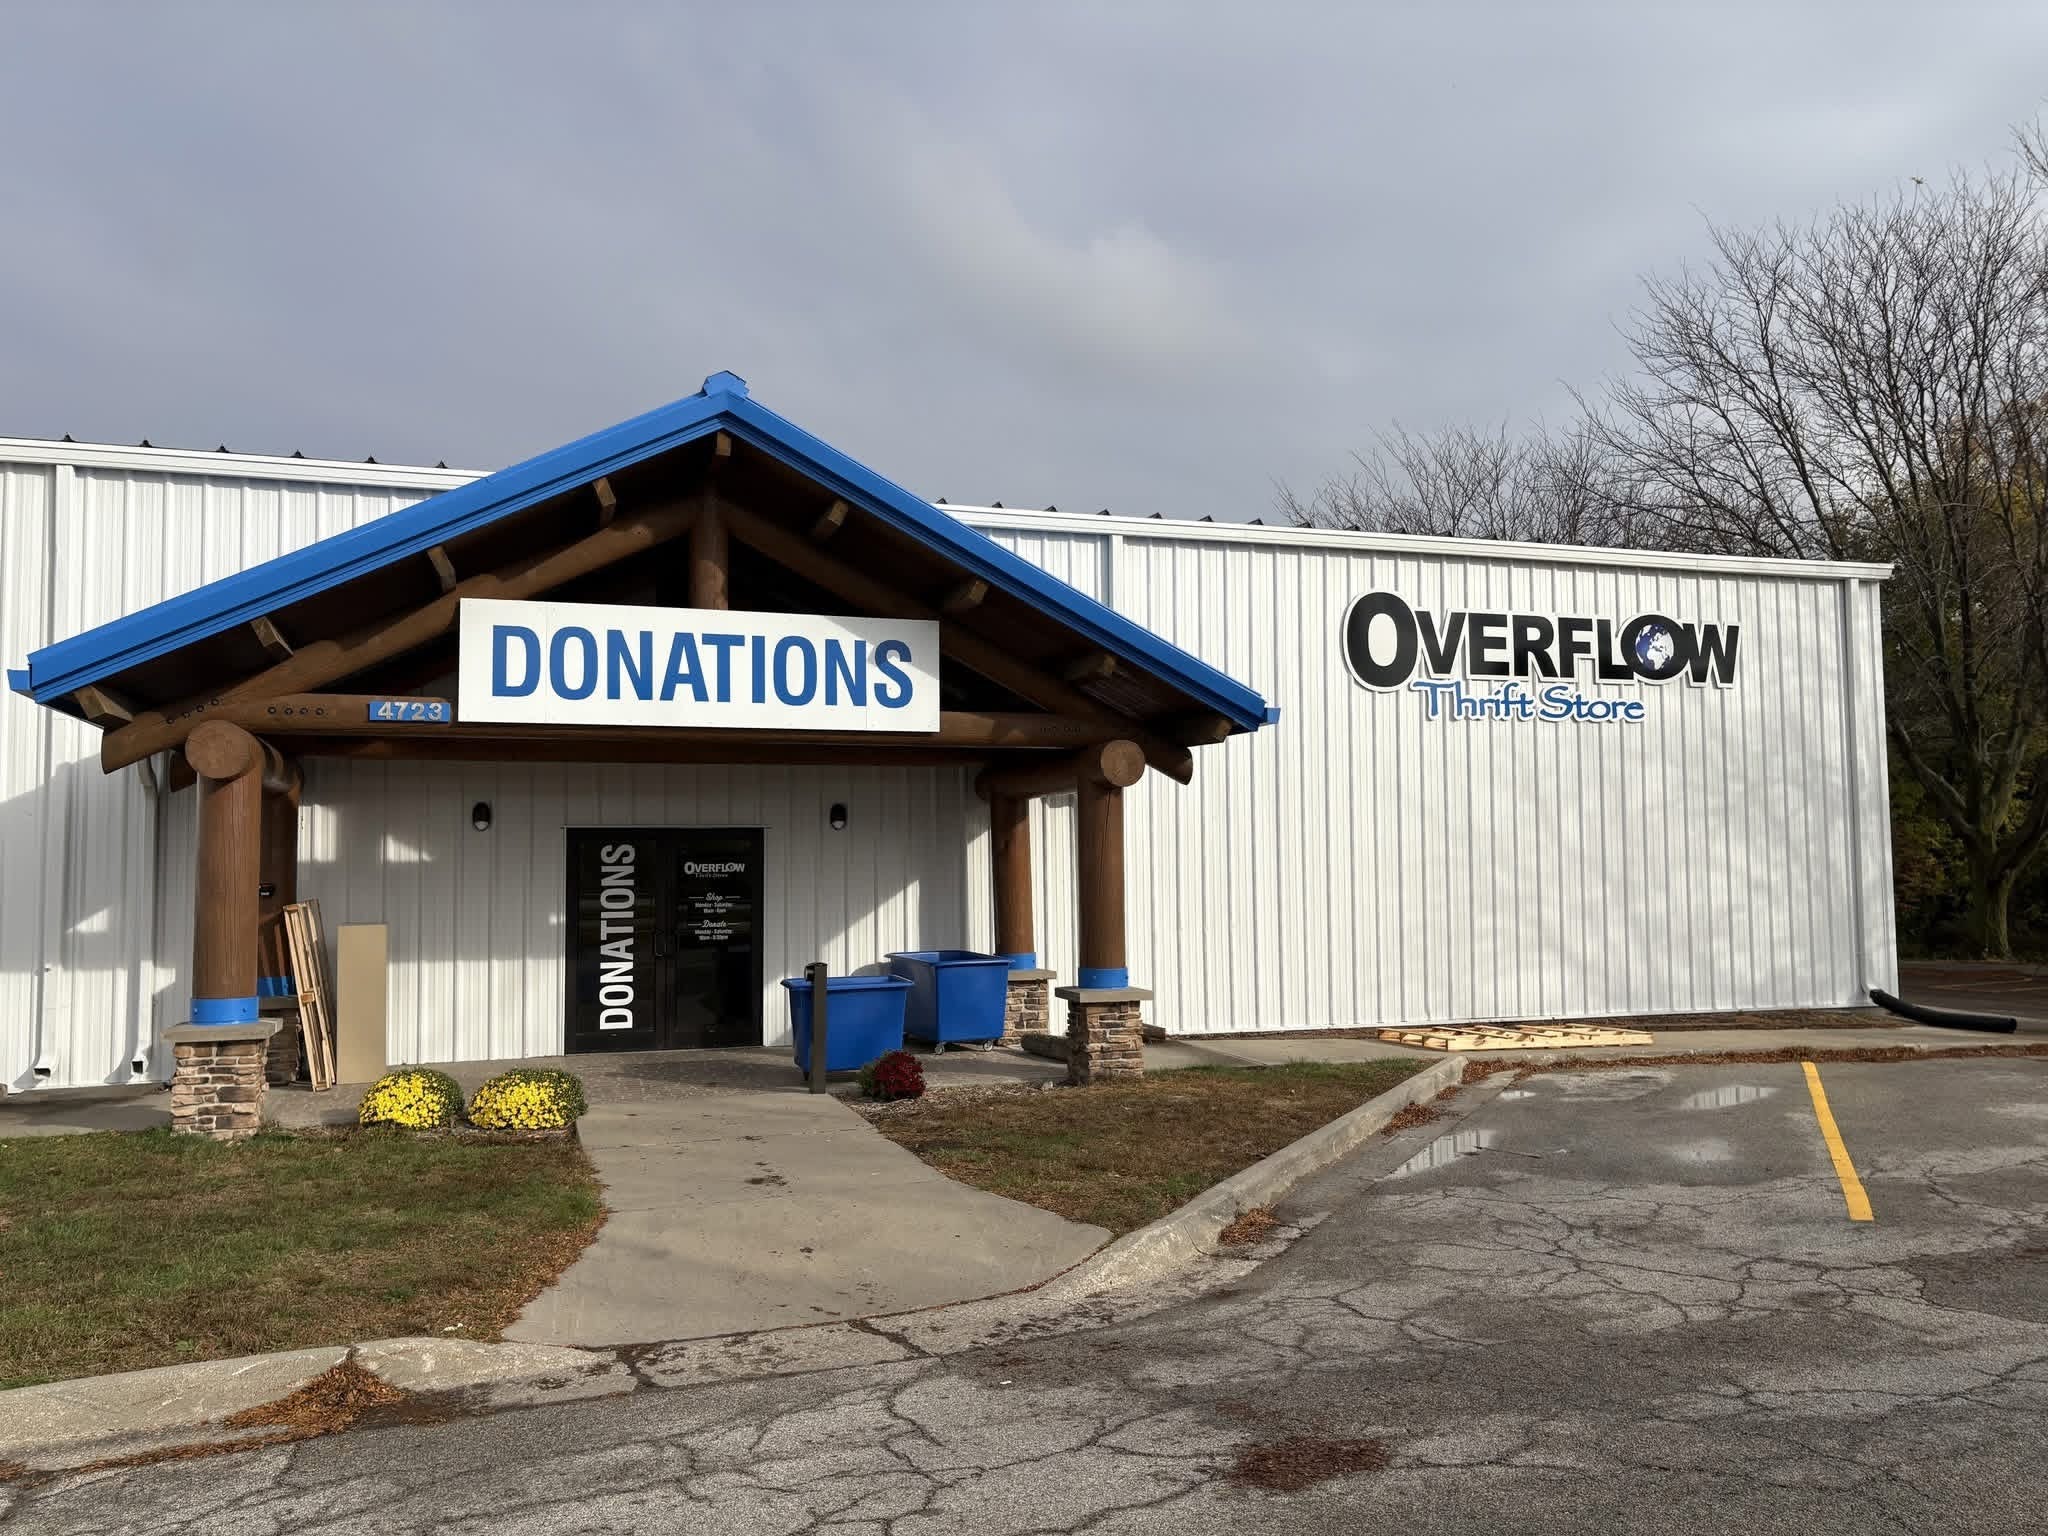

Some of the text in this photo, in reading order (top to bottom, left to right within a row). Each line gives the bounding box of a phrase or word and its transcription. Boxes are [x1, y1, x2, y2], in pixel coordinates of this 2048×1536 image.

[1346, 591, 1740, 688] OVERFLOW
[491, 624, 914, 710] DONATIONS
[377, 701, 443, 721] 4723
[1412, 681, 1646, 721] Thrift Store
[684, 861, 746, 875] OVERFLOW
[705, 892, 723, 902] Shop
[599, 844, 636, 1030] DONATIONS
[701, 919, 728, 928] Donate
